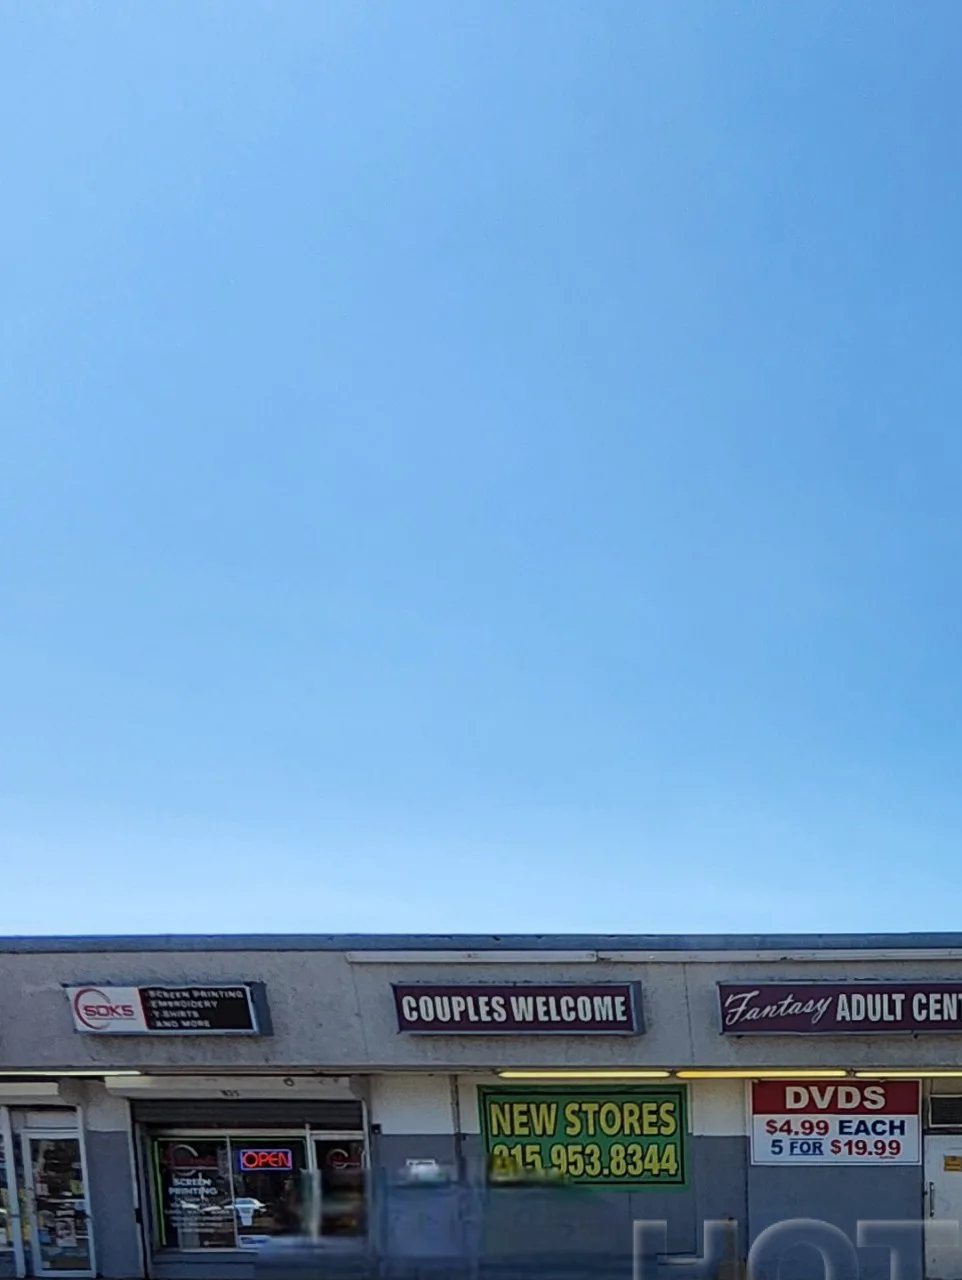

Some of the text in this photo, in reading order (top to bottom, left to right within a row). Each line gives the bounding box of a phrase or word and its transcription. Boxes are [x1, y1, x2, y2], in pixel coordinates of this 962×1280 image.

[147, 990, 244, 998] SCREEN PRINTING
[150, 1001, 218, 1009] EMBROIDERY
[401, 995, 628, 1022] COUPLES WELCOME
[725, 990, 833, 1026] Fantasy
[836, 993, 906, 1021] ADULT
[785, 1086, 886, 1109] DVDS
[489, 1102, 677, 1136] NEW STORES
[765, 1119, 905, 1136] $4.99 EACH
[771, 1139, 901, 1156] 5 FOR $19.99
[243, 1150, 290, 1168] OPEN
[493, 1144, 678, 1177] 15953.8344
[172, 1178, 212, 1187] SCREEN
[168, 1187, 218, 1196] PRINTING
